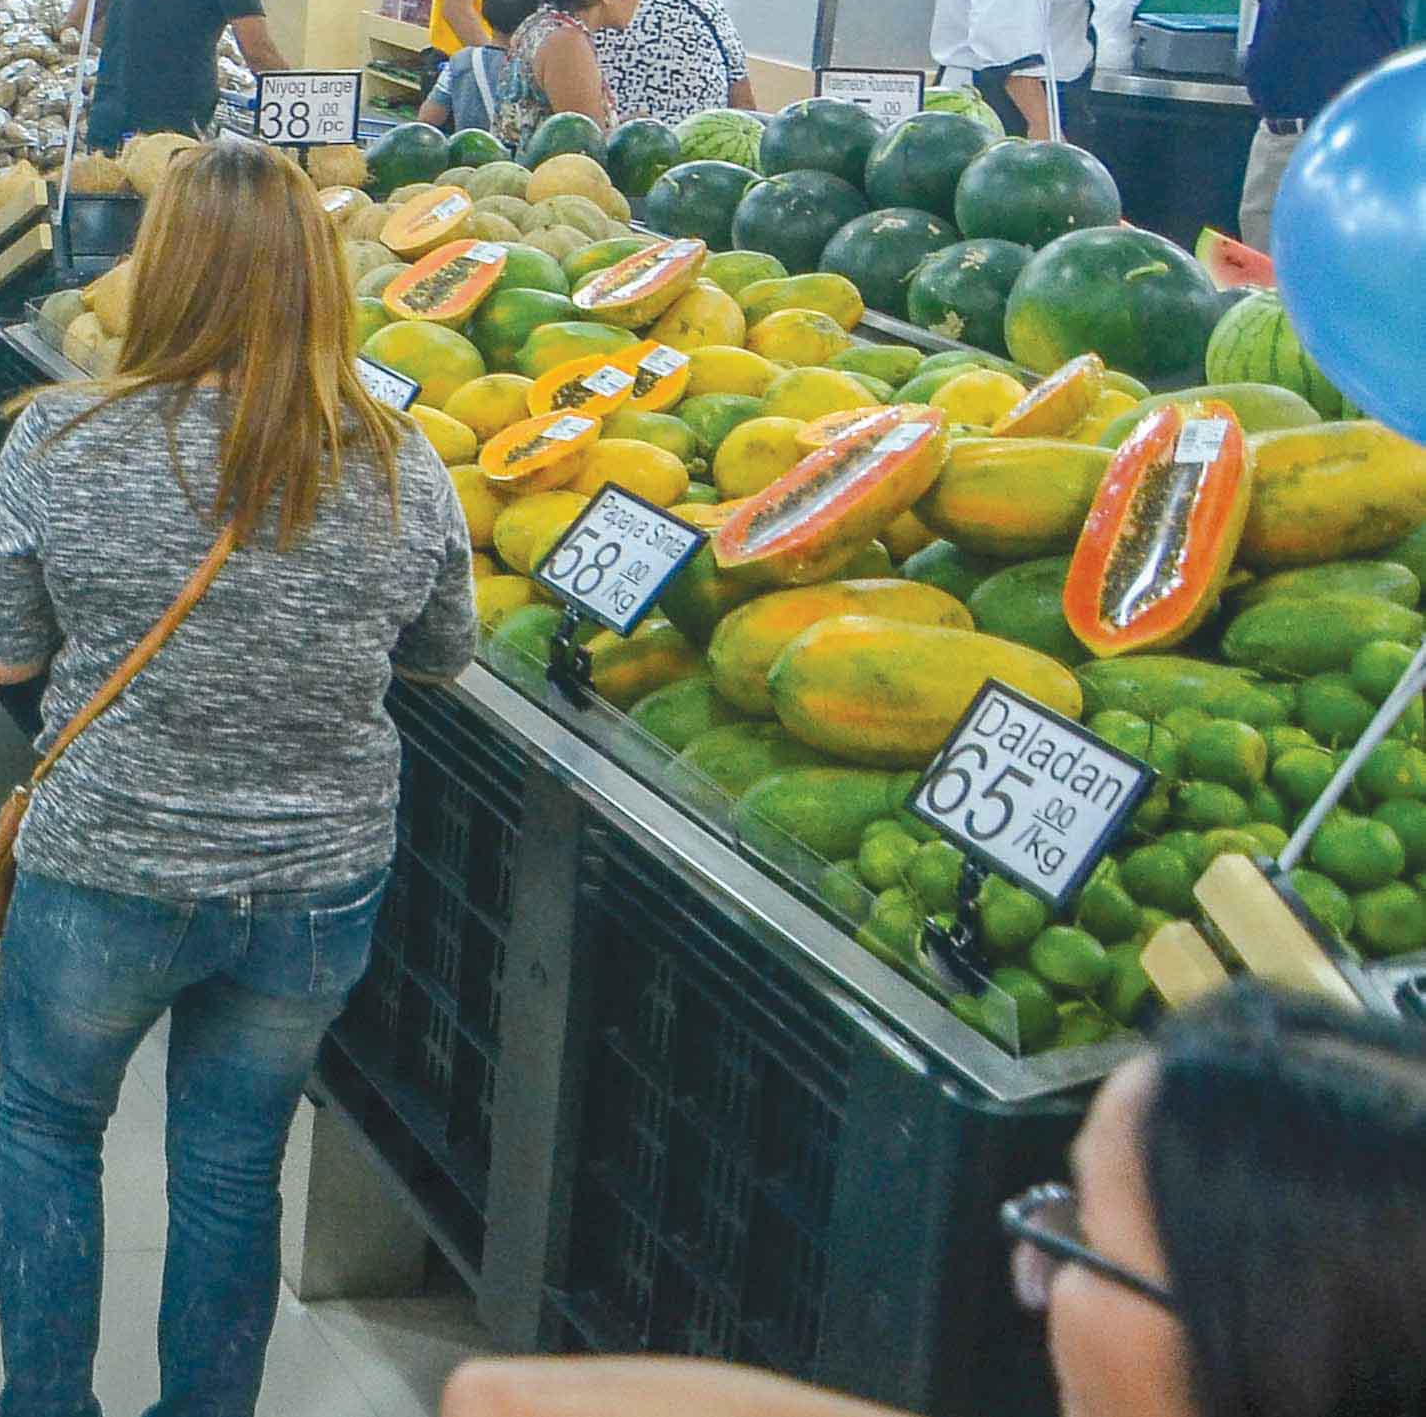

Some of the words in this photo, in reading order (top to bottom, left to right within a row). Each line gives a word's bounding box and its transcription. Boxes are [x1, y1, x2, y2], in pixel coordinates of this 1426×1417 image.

[265, 78, 307, 98] Niyog
[311, 78, 354, 98] Large
[259, 101, 310, 140] 38
[316, 118, 344, 136] /pc
[601, 493, 650, 540] Papaya
[645, 522, 687, 560] Sinta
[548, 525, 622, 596] 58
[602, 579, 638, 615] /kg
[972, 695, 1125, 813] Daladan
[925, 743, 1035, 842] 65
[1011, 822, 1069, 877] /kg
